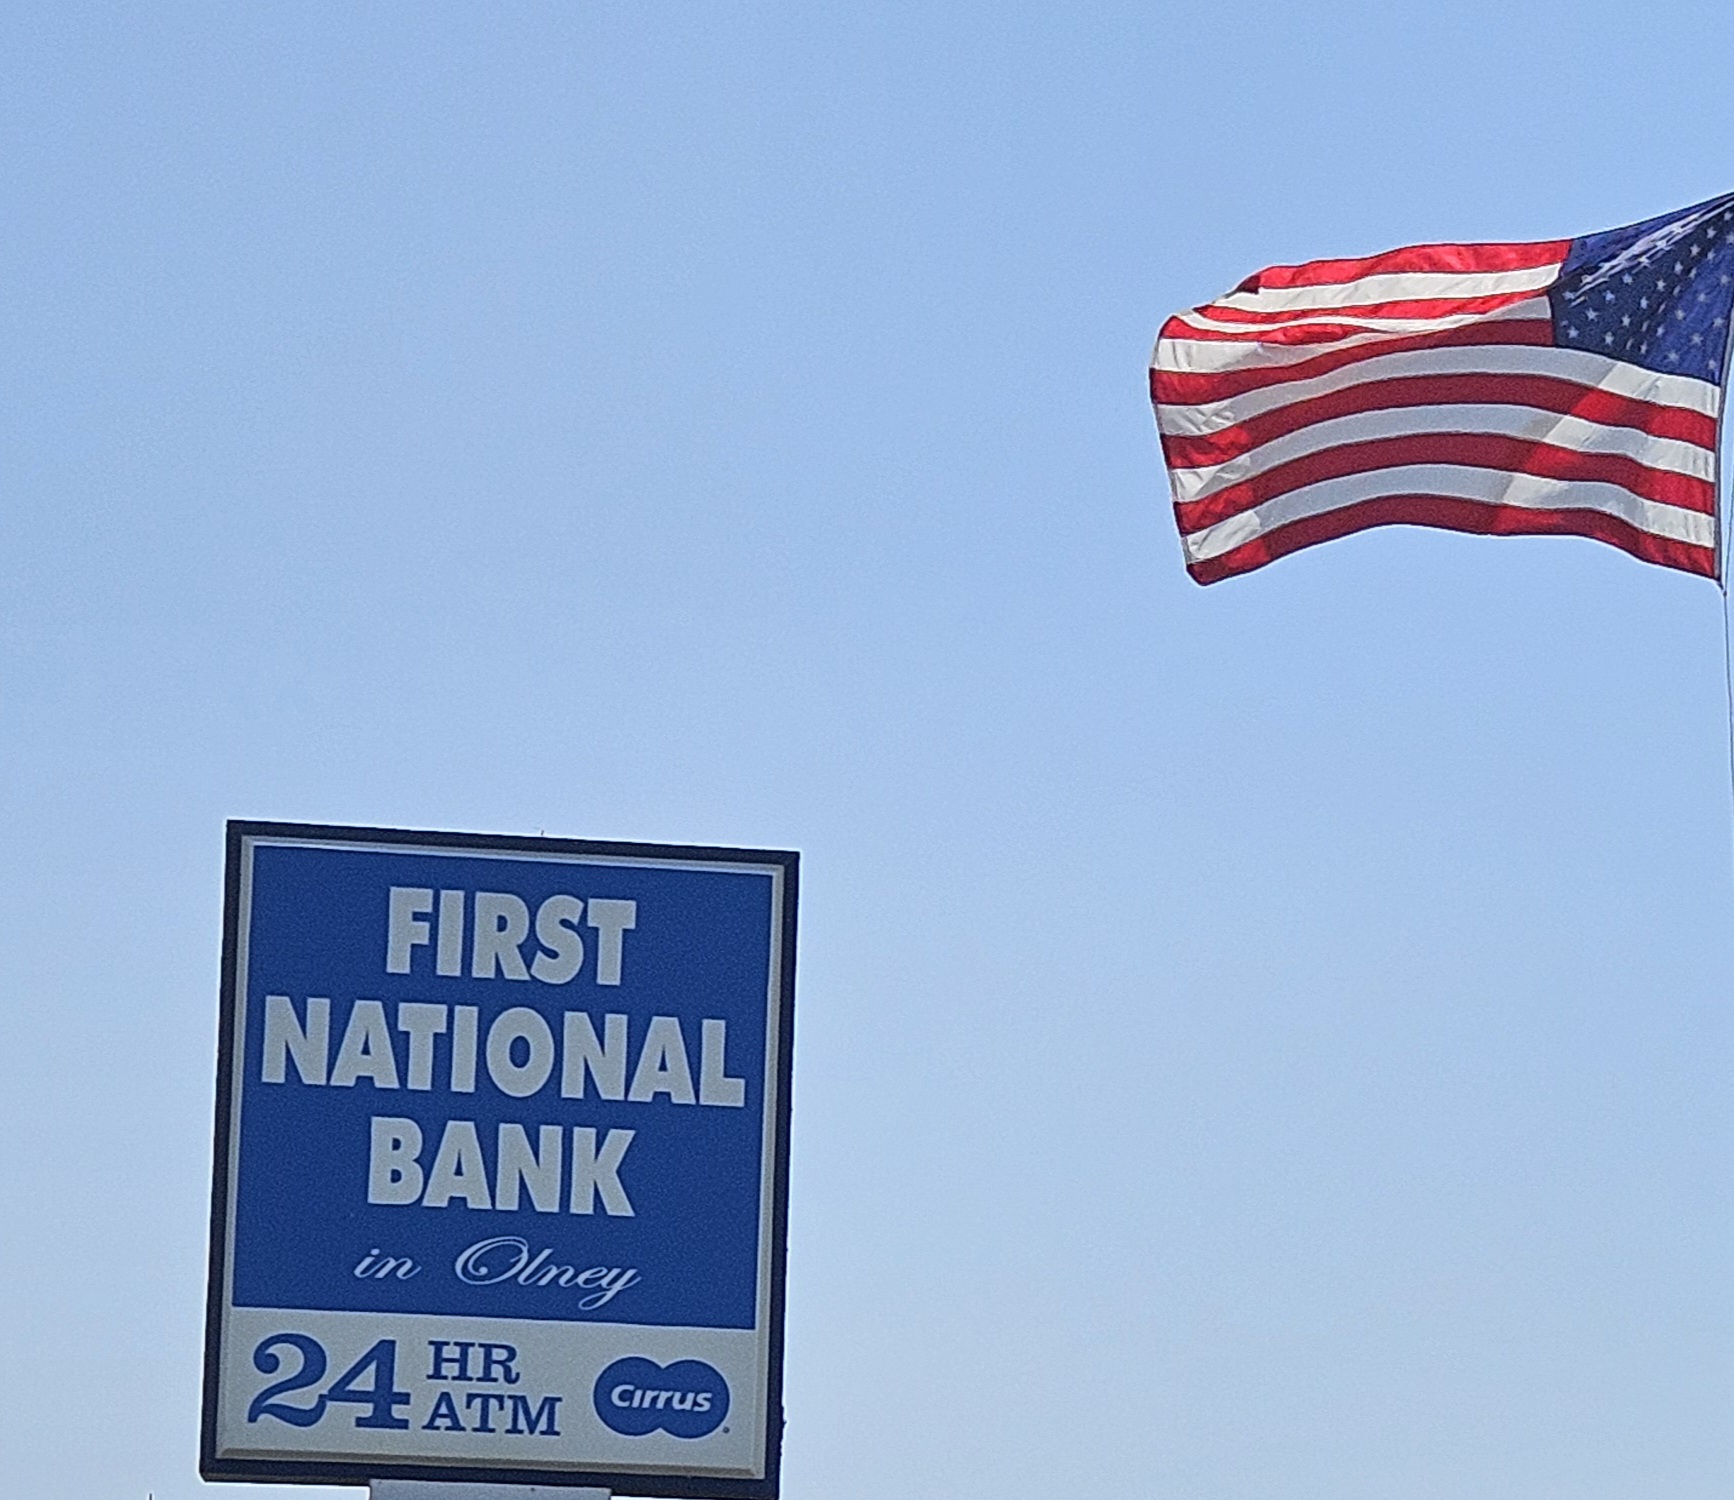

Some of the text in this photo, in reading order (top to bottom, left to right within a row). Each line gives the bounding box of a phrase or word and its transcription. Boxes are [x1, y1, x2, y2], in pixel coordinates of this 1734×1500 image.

[386, 886, 636, 986] FIRST
[261, 995, 746, 1107] NATIONAL
[367, 1115, 636, 1217] BANK
[353, 1236, 641, 1310] in Olney
[247, 1333, 520, 1430] 24 HR
[421, 1391, 563, 1436] ATM
[610, 1384, 713, 1414] Cirrus
